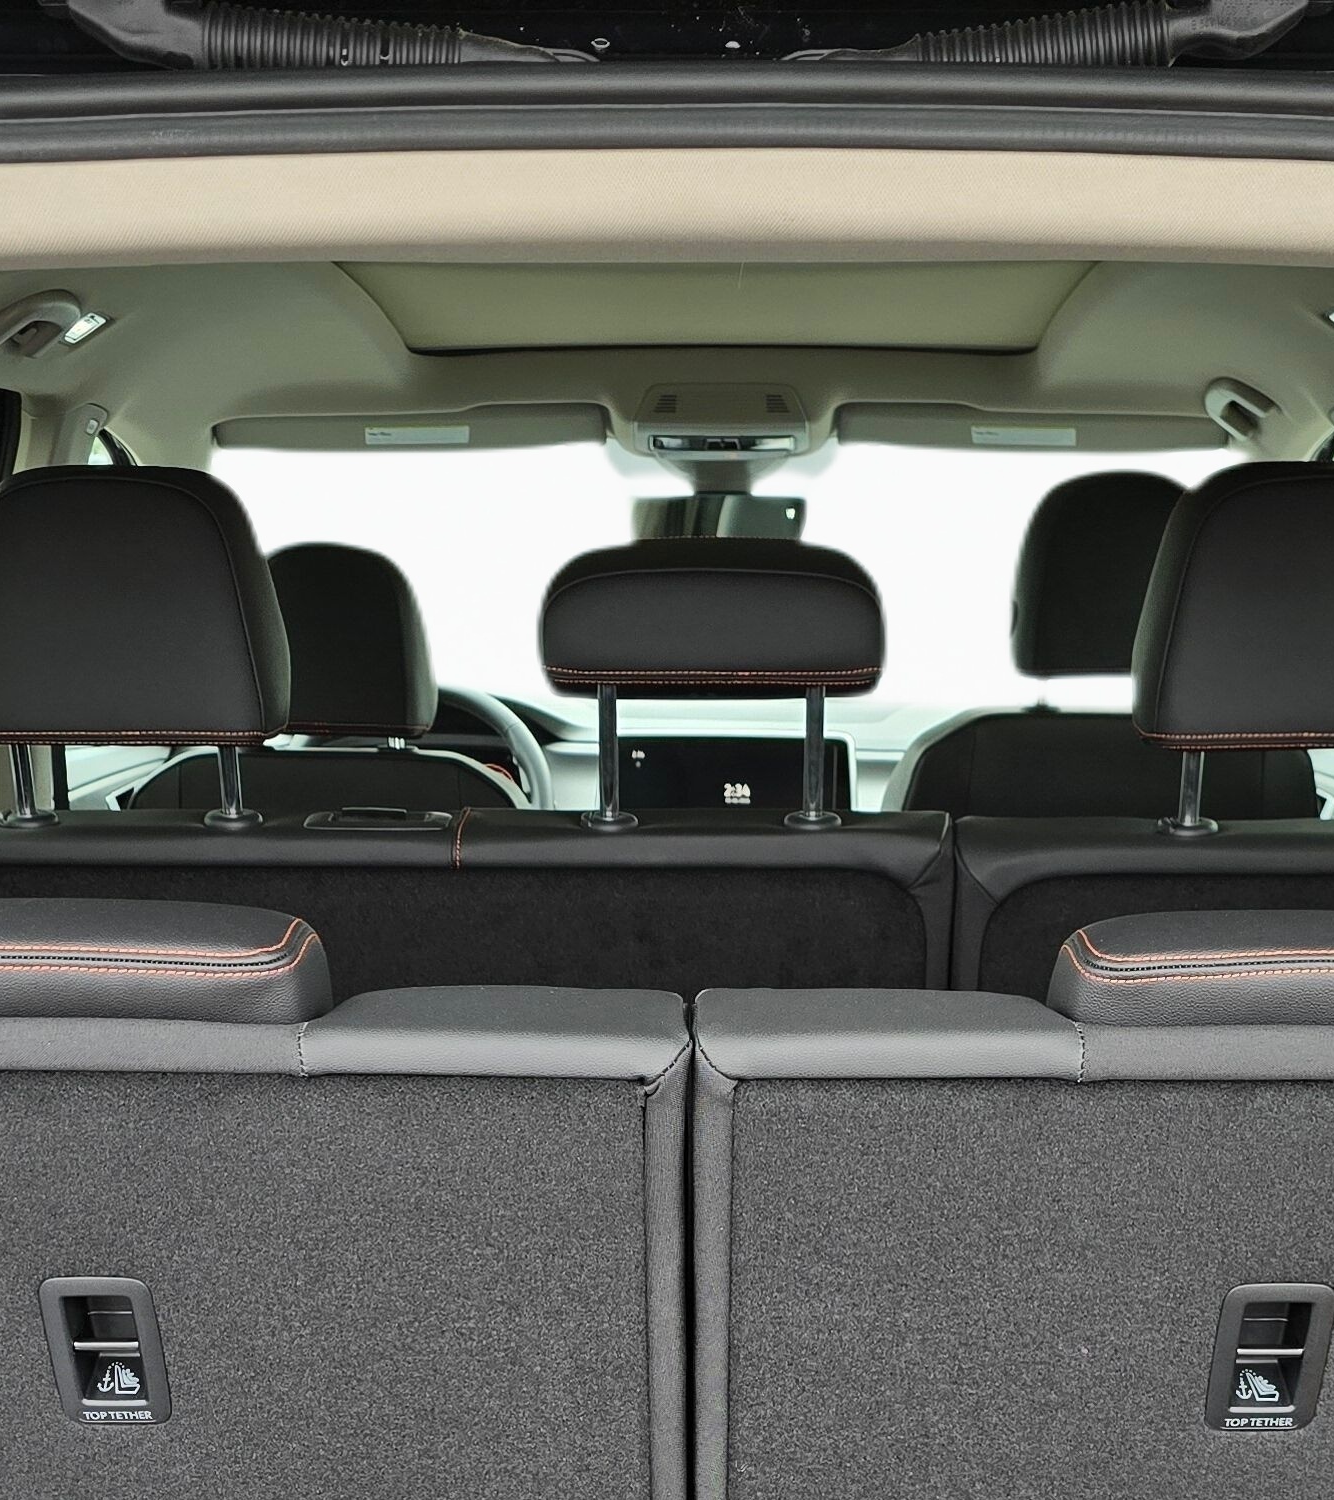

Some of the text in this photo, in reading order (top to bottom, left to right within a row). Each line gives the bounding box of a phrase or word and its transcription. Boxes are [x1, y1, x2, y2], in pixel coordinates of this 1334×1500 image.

[83, 1410, 153, 1421] TOP TETHER
[1224, 1417, 1294, 1427] TOP TETHER
